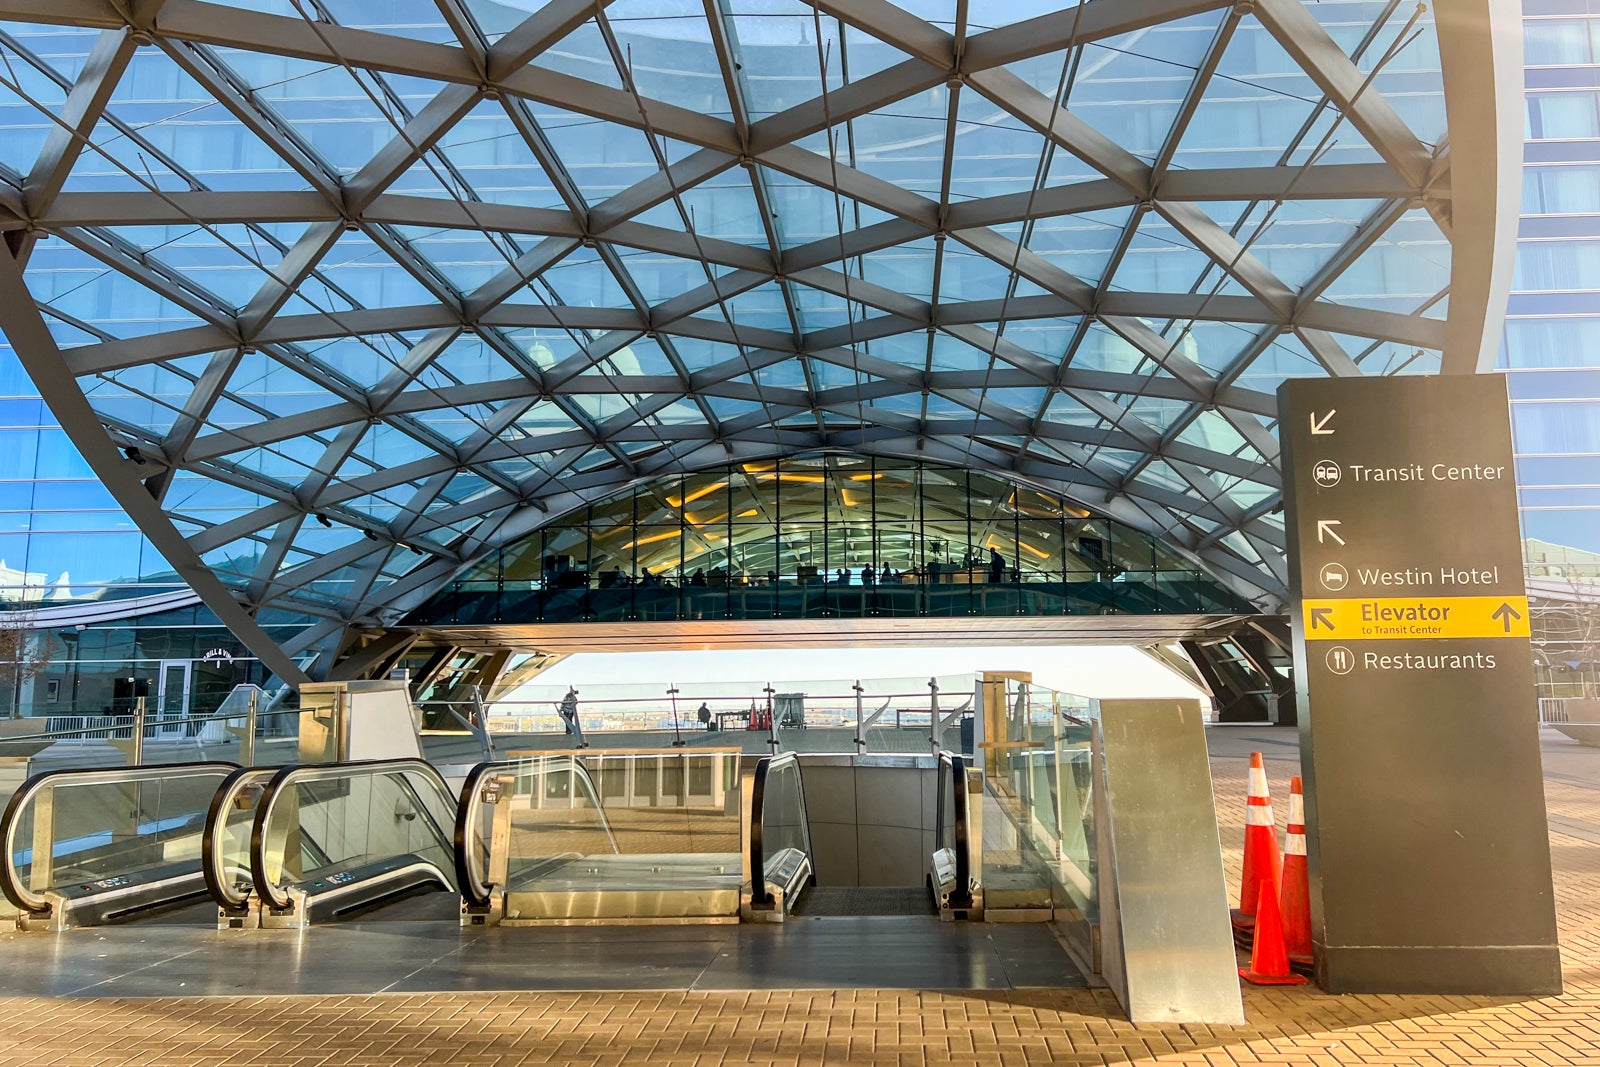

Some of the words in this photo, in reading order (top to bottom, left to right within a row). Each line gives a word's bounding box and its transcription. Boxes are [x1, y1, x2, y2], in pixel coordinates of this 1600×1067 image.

[1350, 463, 1425, 482] Transit
[1431, 463, 1505, 481] Center
[1357, 569, 1433, 586] Westin
[1440, 566, 1499, 585] Hotel
[1361, 603, 1450, 622] Elevator
[1362, 626, 1373, 635] to
[1374, 625, 1407, 635] Transit
[1409, 625, 1442, 634] Center
[1364, 652, 1497, 669] Restaurants
